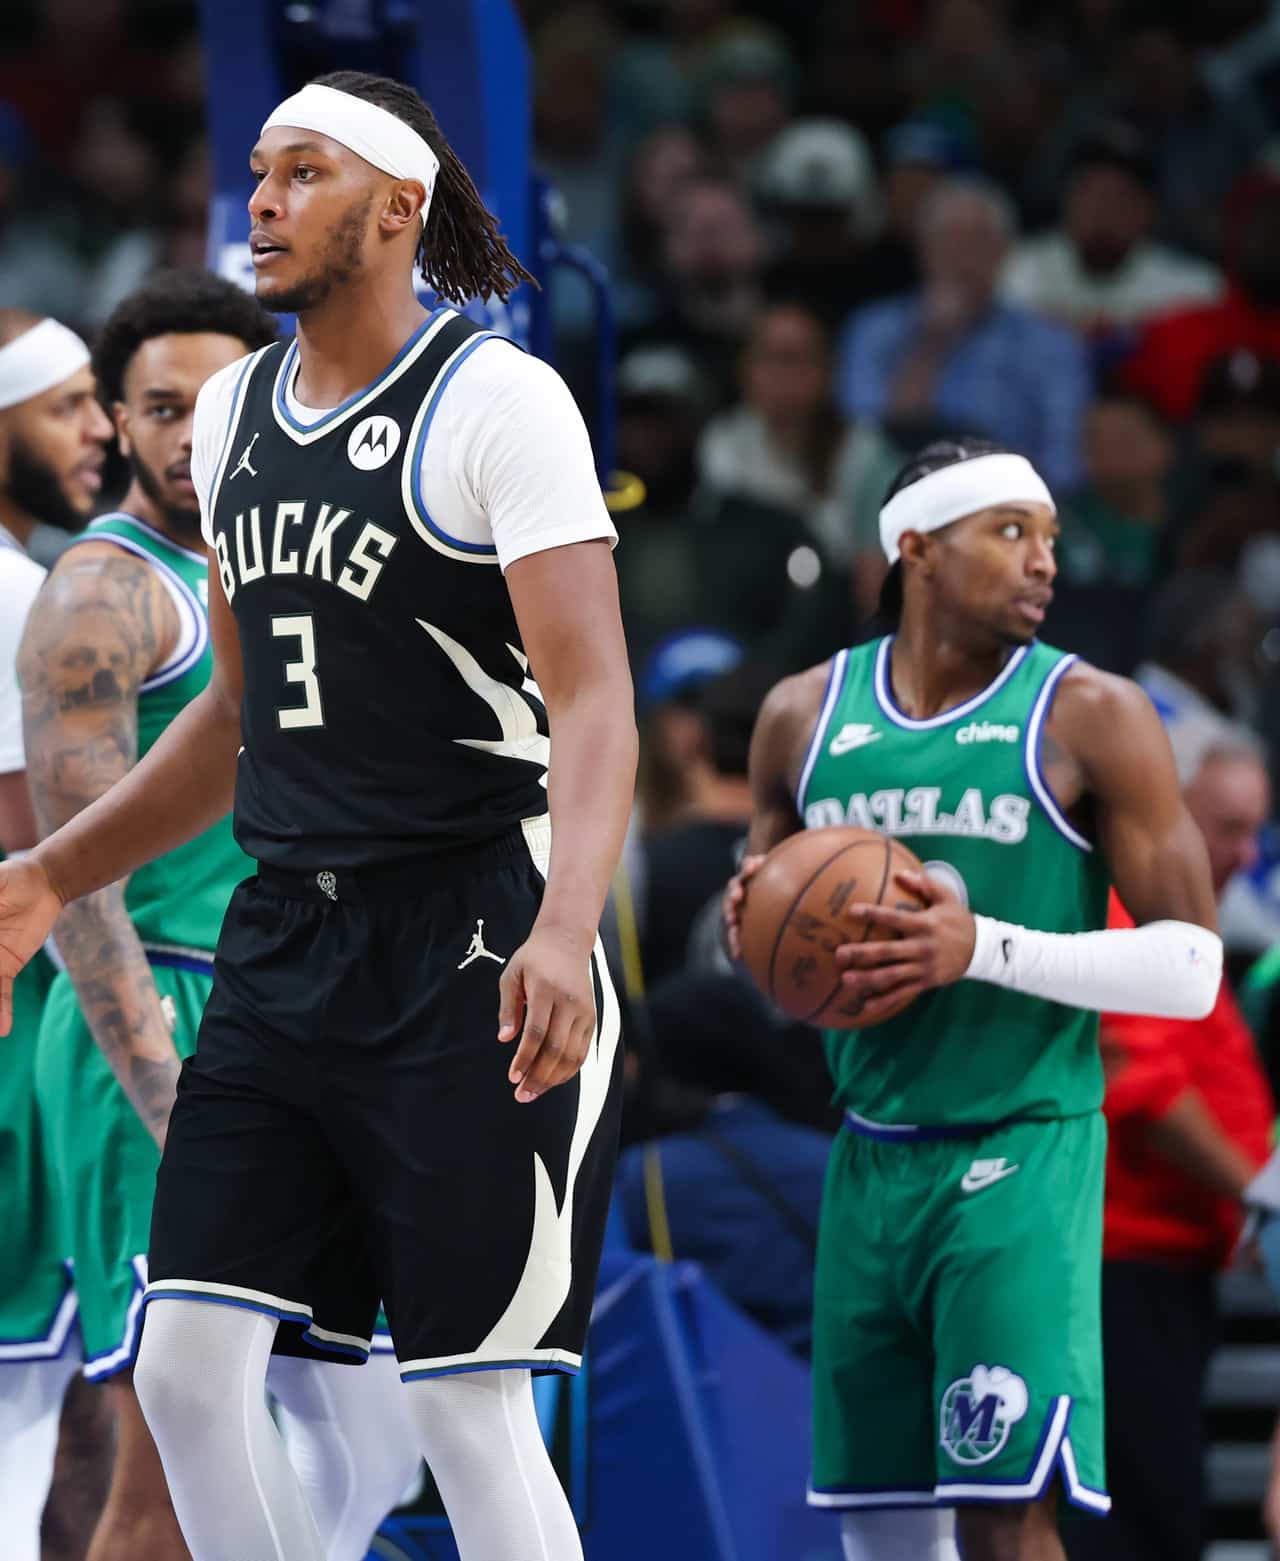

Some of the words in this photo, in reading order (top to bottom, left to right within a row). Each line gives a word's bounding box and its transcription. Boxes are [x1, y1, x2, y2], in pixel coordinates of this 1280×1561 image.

[215, 499, 399, 606] BUCKS
[271, 611, 324, 729] 3
[955, 720, 1020, 745] chime
[805, 786, 1031, 844] DALLAS
